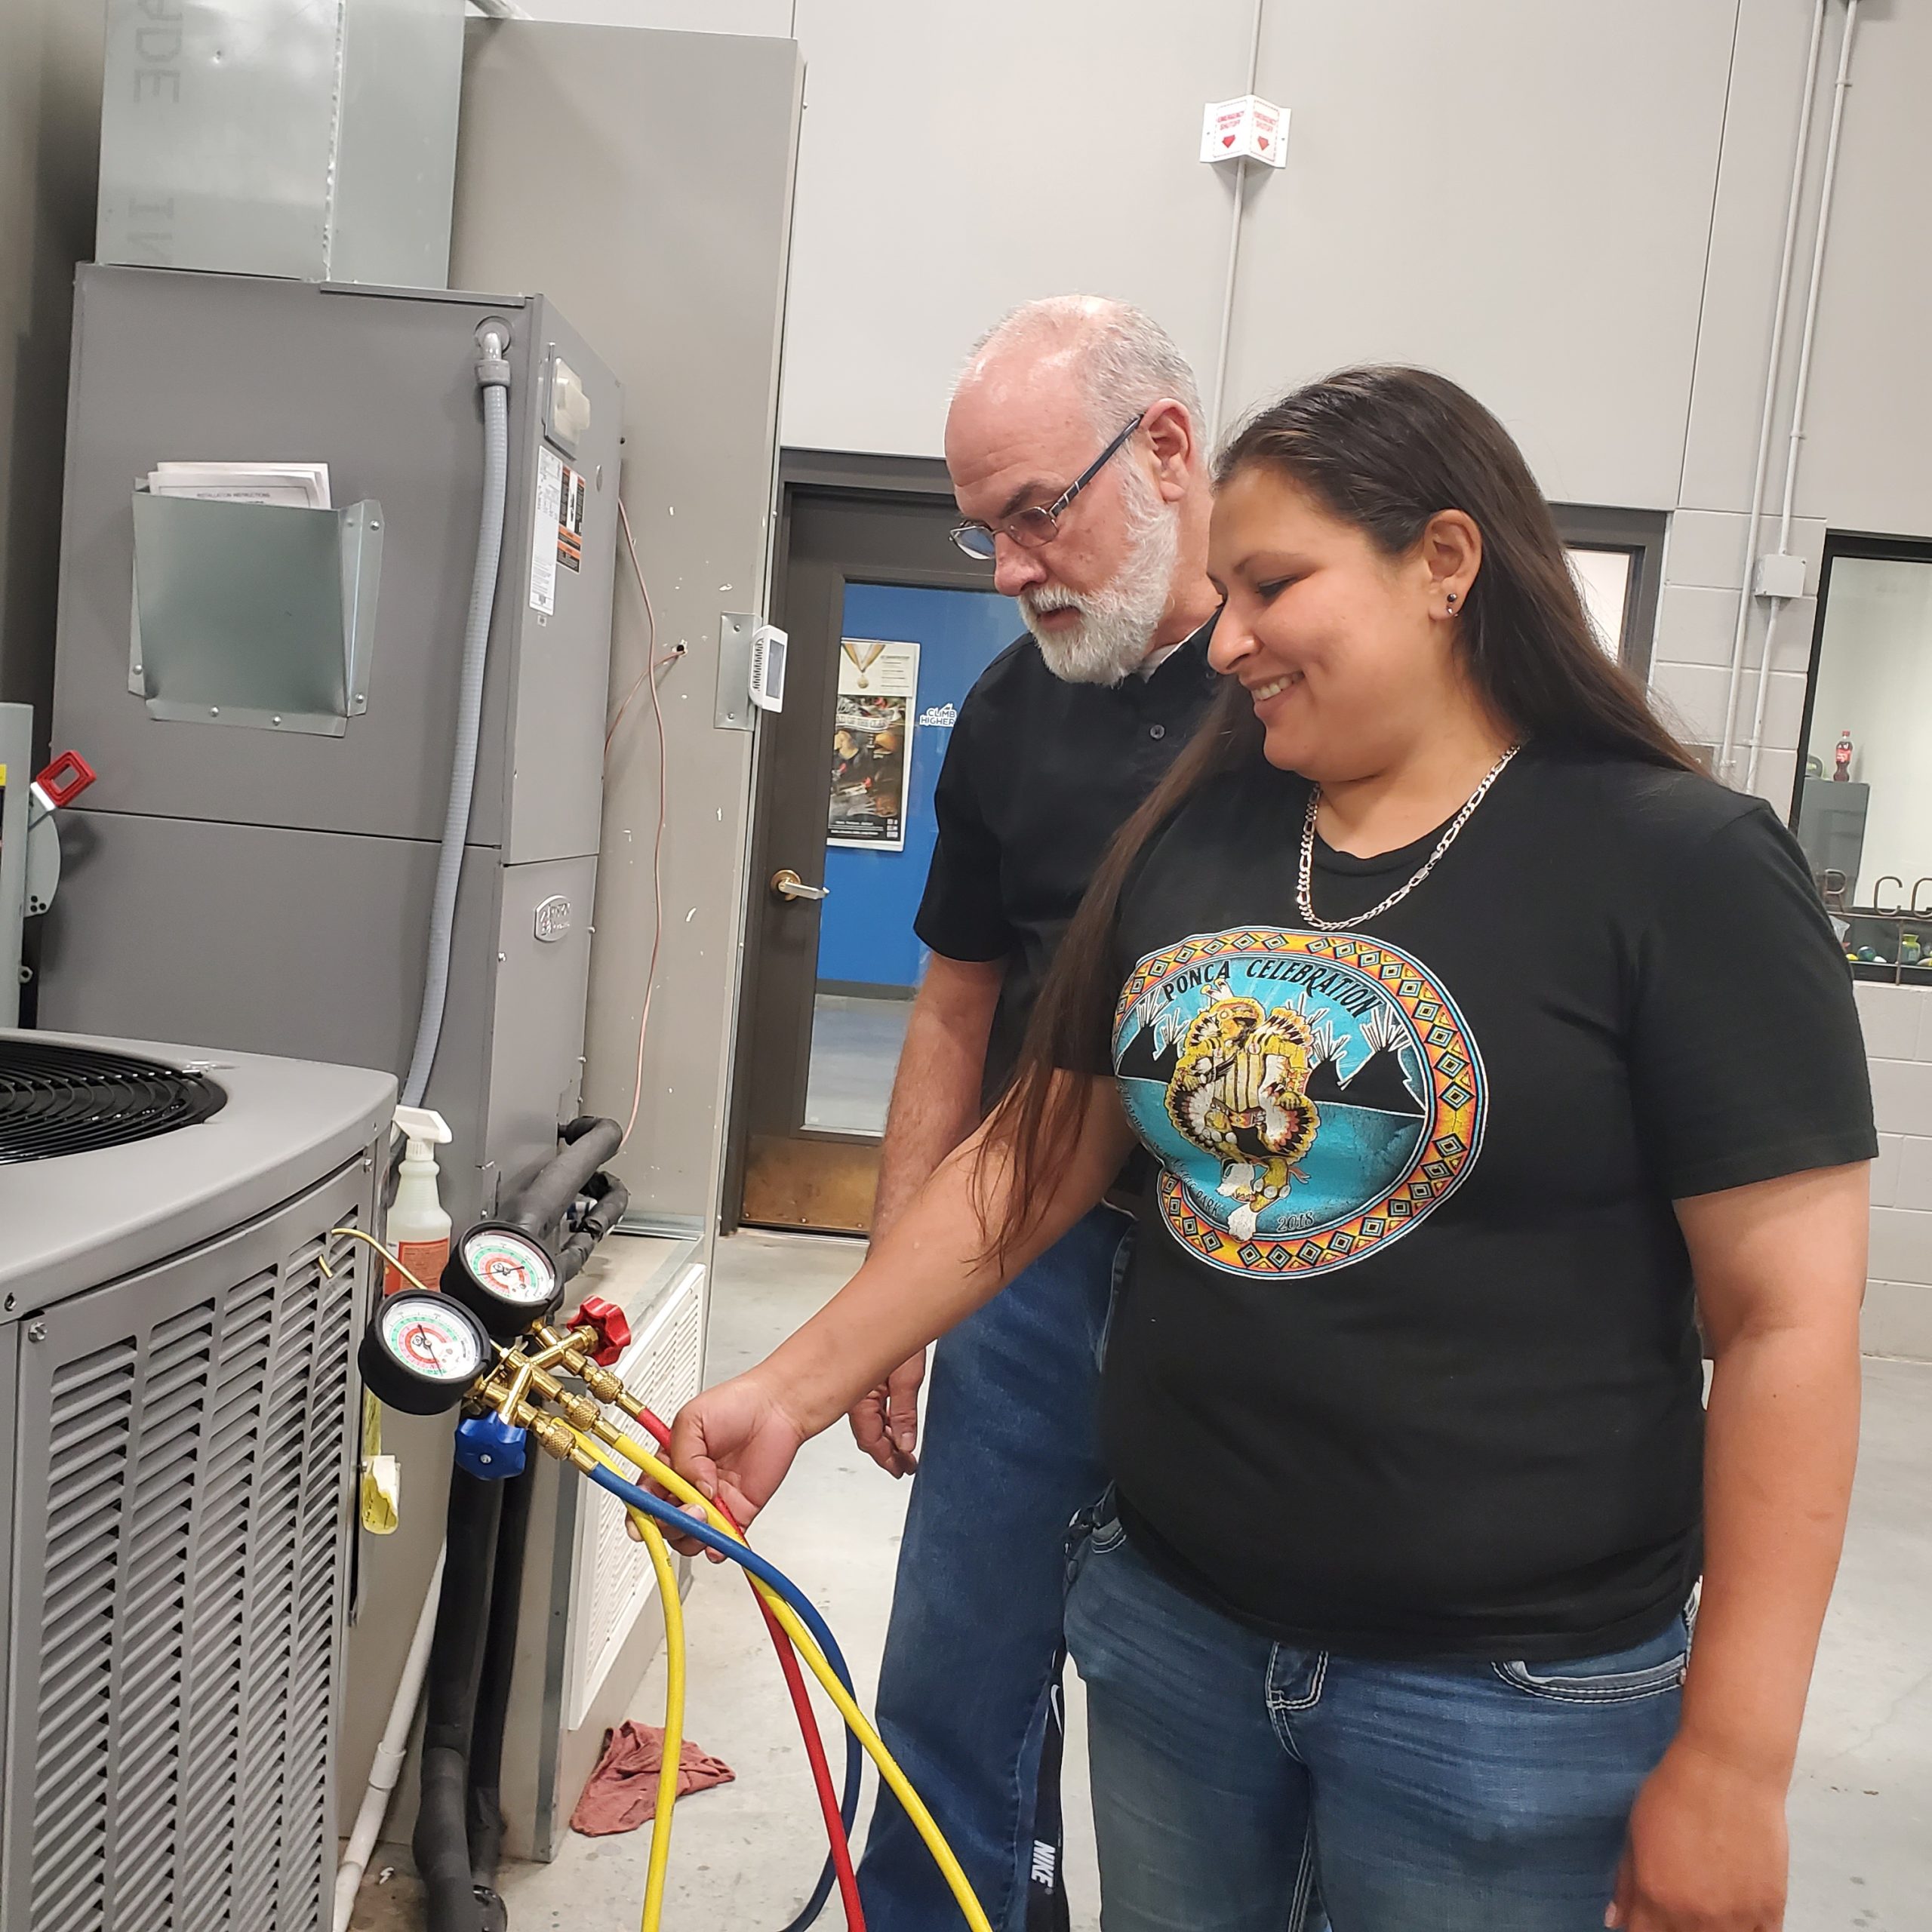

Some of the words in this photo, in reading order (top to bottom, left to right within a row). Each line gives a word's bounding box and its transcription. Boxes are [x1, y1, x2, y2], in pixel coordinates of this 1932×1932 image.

[921, 716, 955, 725] HIGHER
[928, 709, 955, 718] CLIMB
[1162, 959, 1231, 1002] PONCA
[1246, 958, 1384, 1019] CELEBRATION
[1196, 1189, 1220, 1217] PARK
[1276, 1211, 1315, 1232] 2018
[1031, 1839, 1056, 1888] NIKE
